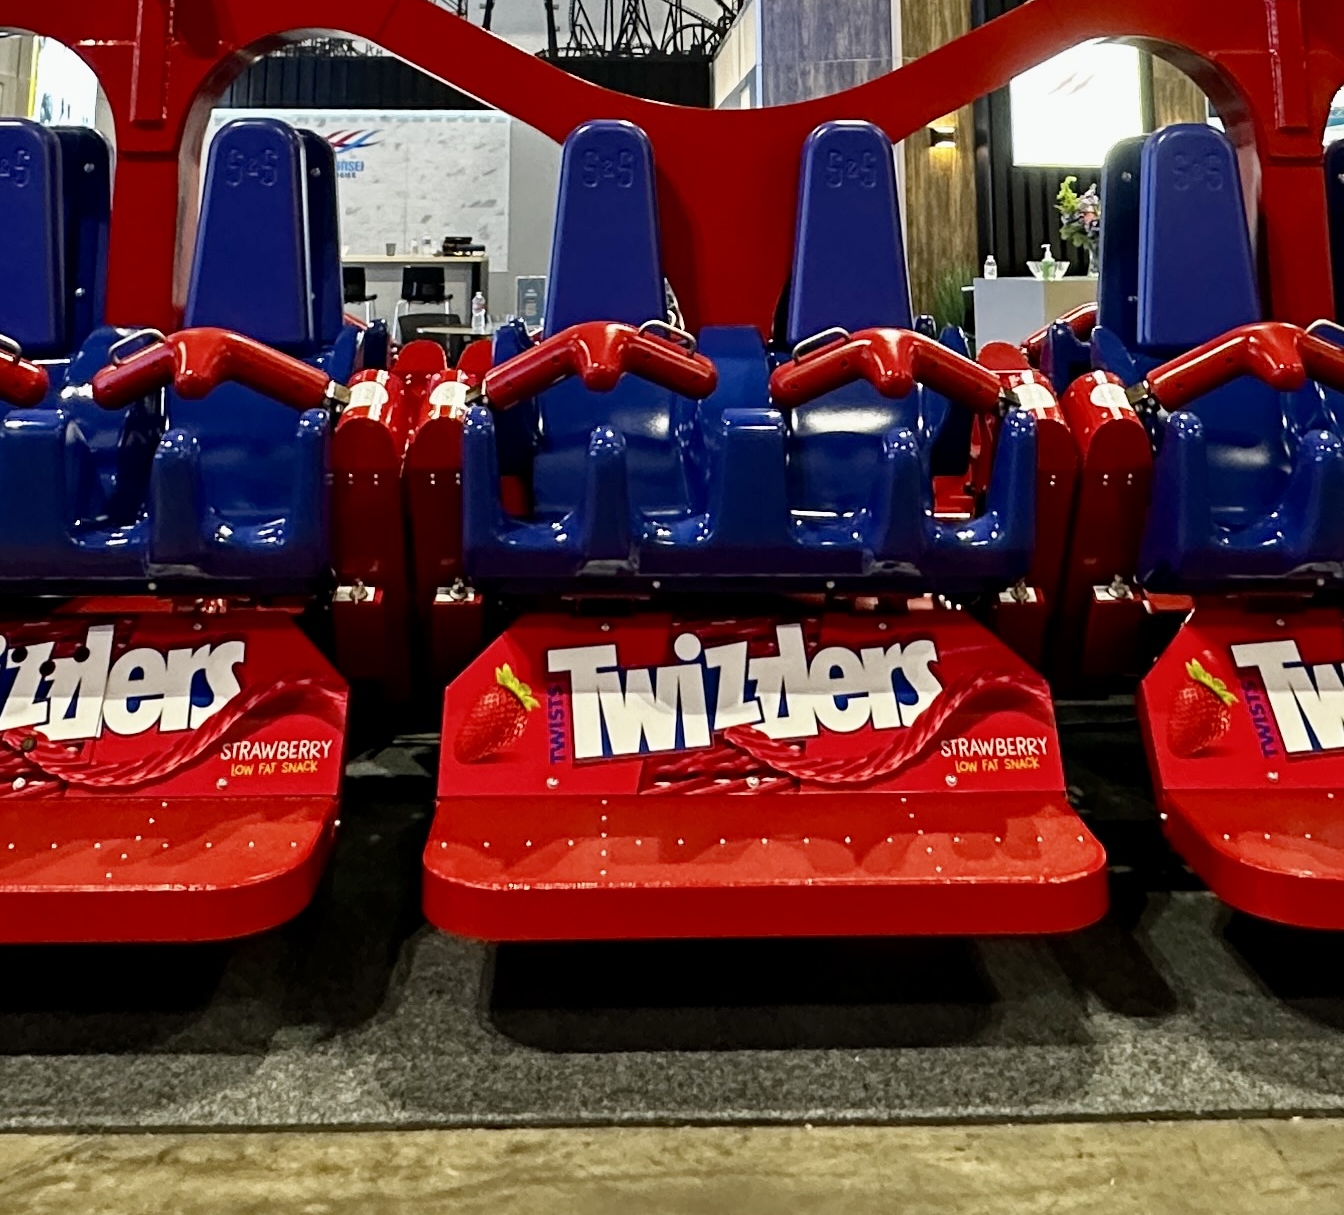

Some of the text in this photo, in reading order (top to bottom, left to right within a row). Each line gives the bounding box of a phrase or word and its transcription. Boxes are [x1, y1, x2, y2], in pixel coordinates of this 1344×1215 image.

[220, 739, 332, 761] STRAWBERRY
[940, 736, 1048, 757] STRAWBERRY
[231, 760, 318, 777] LOW FAT SNACK
[954, 756, 1040, 773] LOW FAT SNACK
